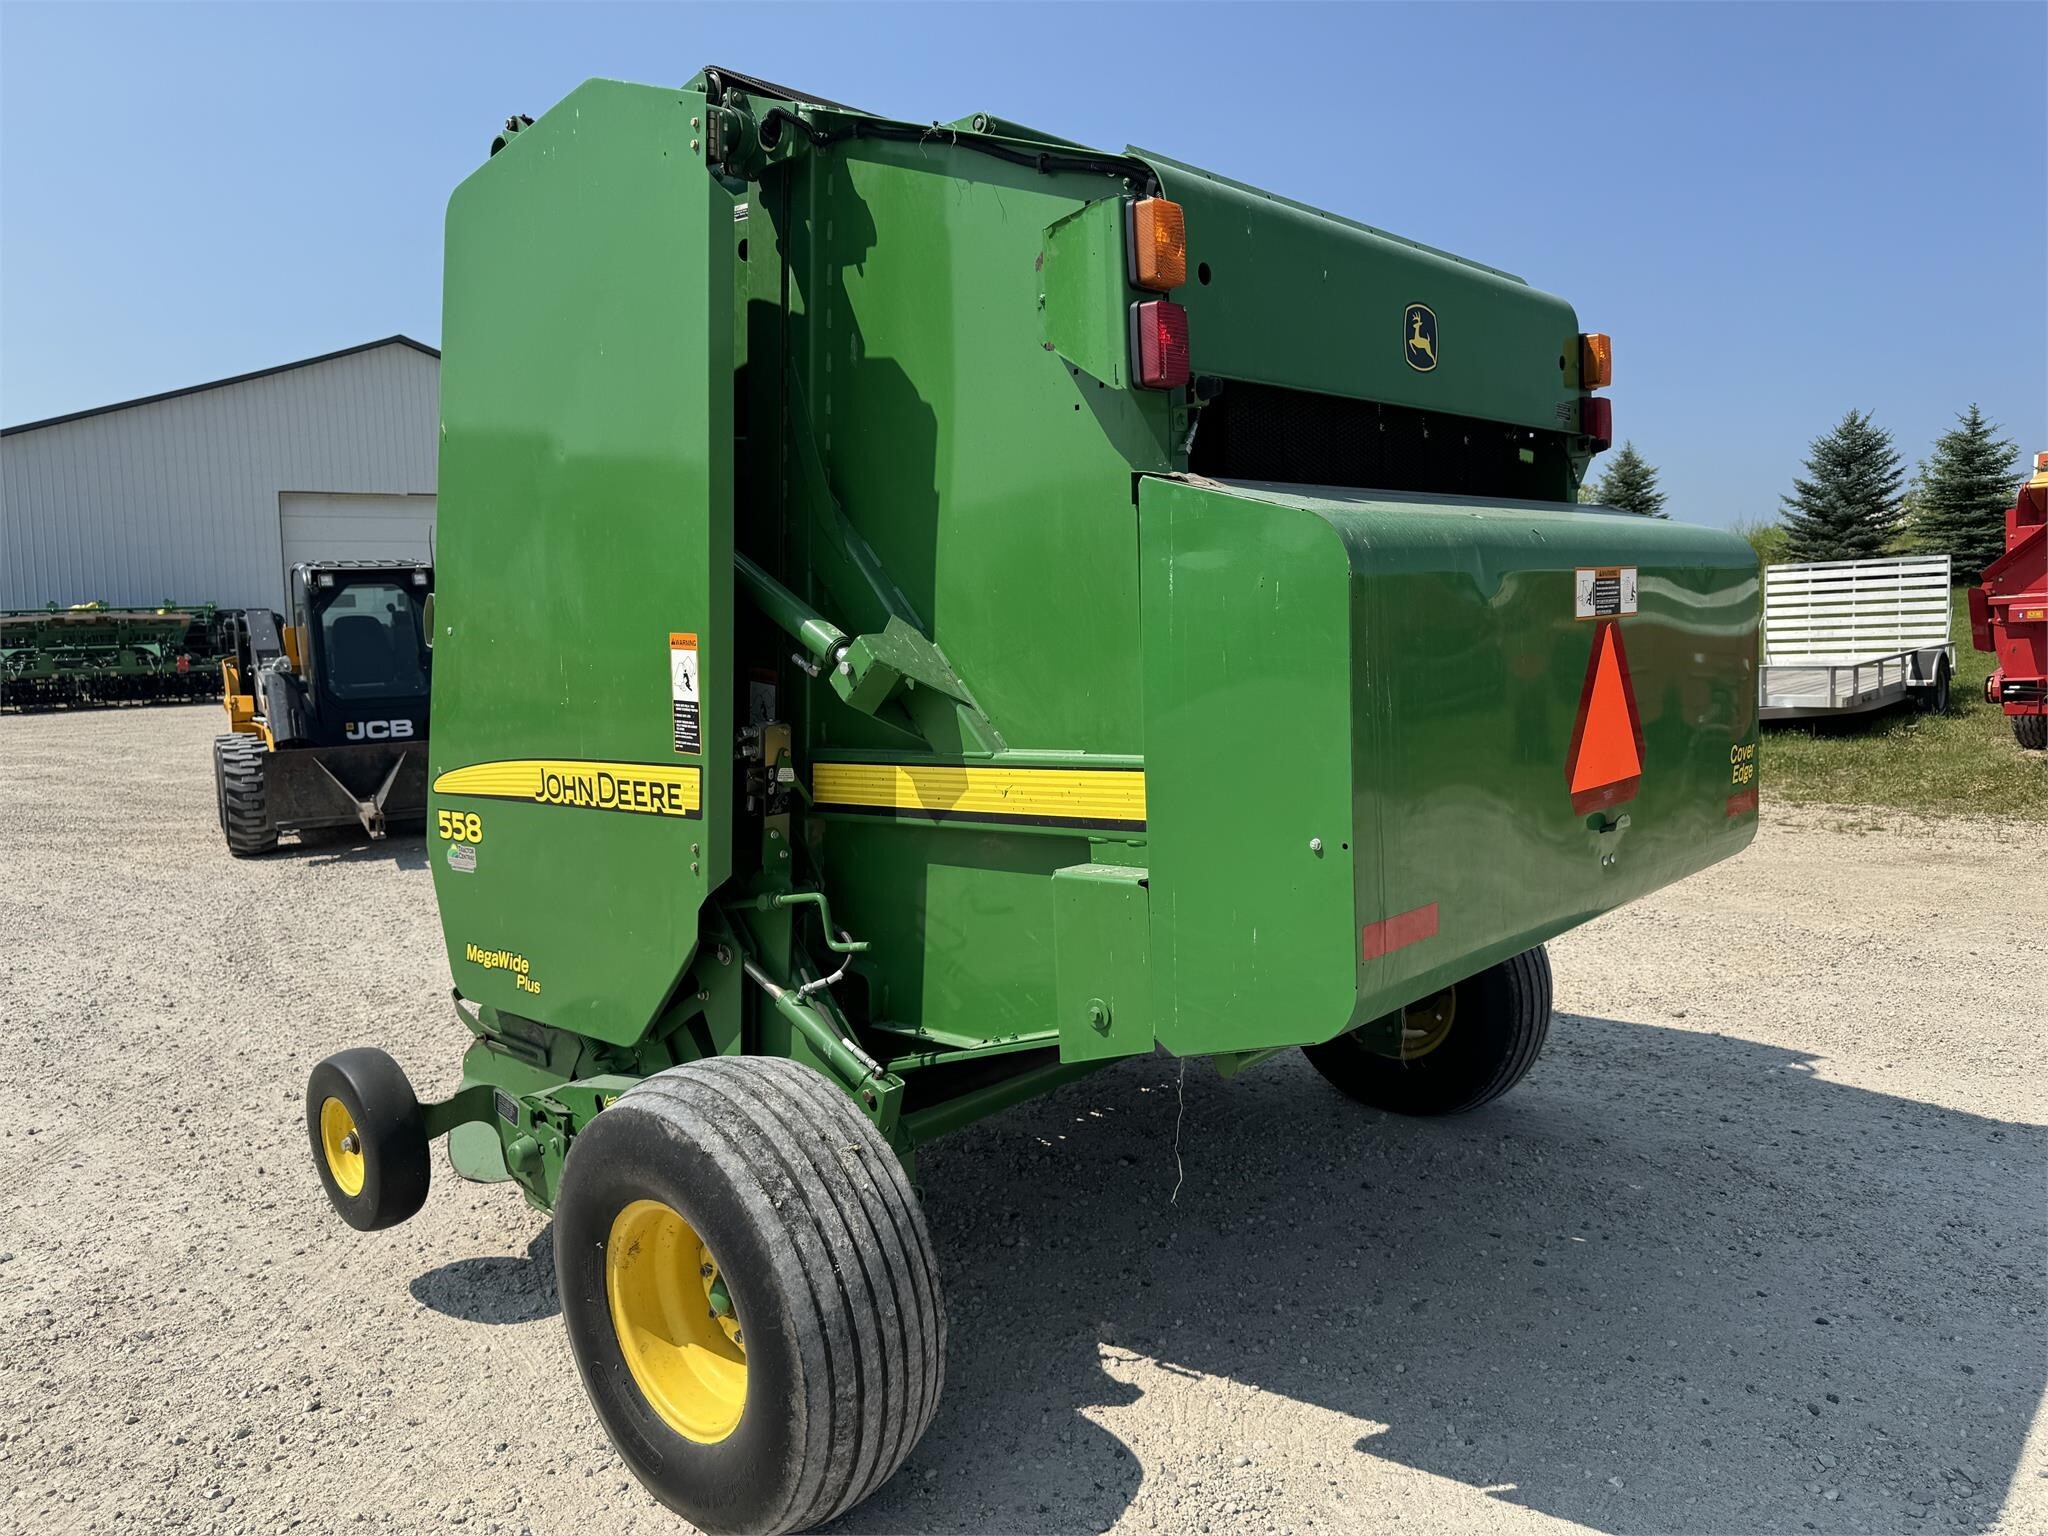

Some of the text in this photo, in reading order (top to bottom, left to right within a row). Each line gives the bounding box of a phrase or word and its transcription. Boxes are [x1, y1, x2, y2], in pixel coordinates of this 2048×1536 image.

[346, 720, 415, 740] JCB
[1730, 743, 1755, 764] Cover
[1732, 762, 1754, 784] Edge
[535, 768, 685, 813] JOHN DEERE
[438, 809, 483, 844] 558
[465, 942, 530, 974] MegaWide
[516, 974, 541, 994] Plus
